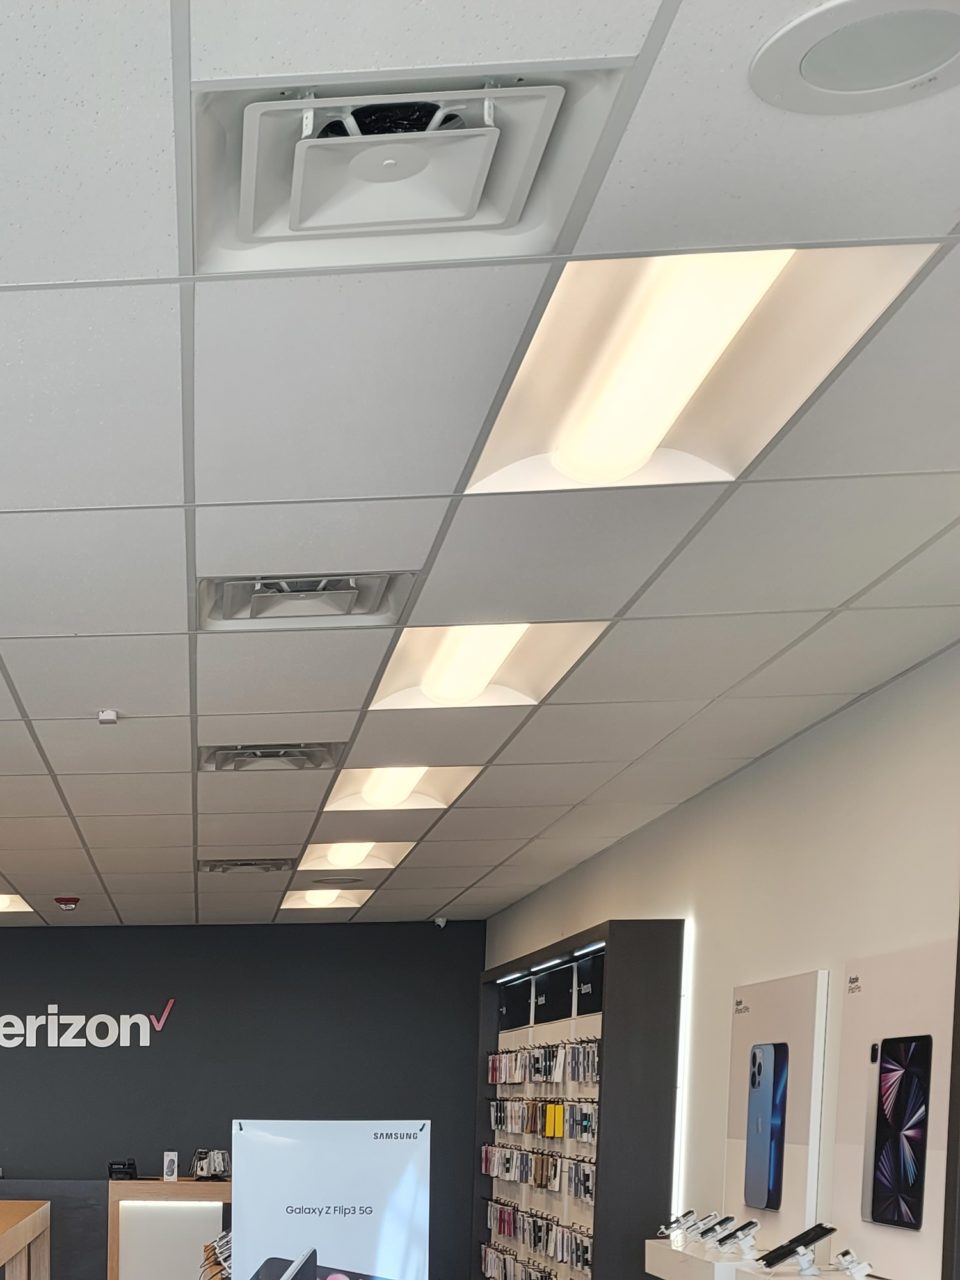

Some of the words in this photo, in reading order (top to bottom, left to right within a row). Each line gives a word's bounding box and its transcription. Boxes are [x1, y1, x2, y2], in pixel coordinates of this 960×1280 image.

[373, 1132, 418, 1140] SAMSUNG
[285, 1205, 324, 1216] Galaxy
[325, 1206, 331, 1215] Z
[333, 1205, 357, 1217] Flip3
[359, 1206, 373, 1215] 5G
